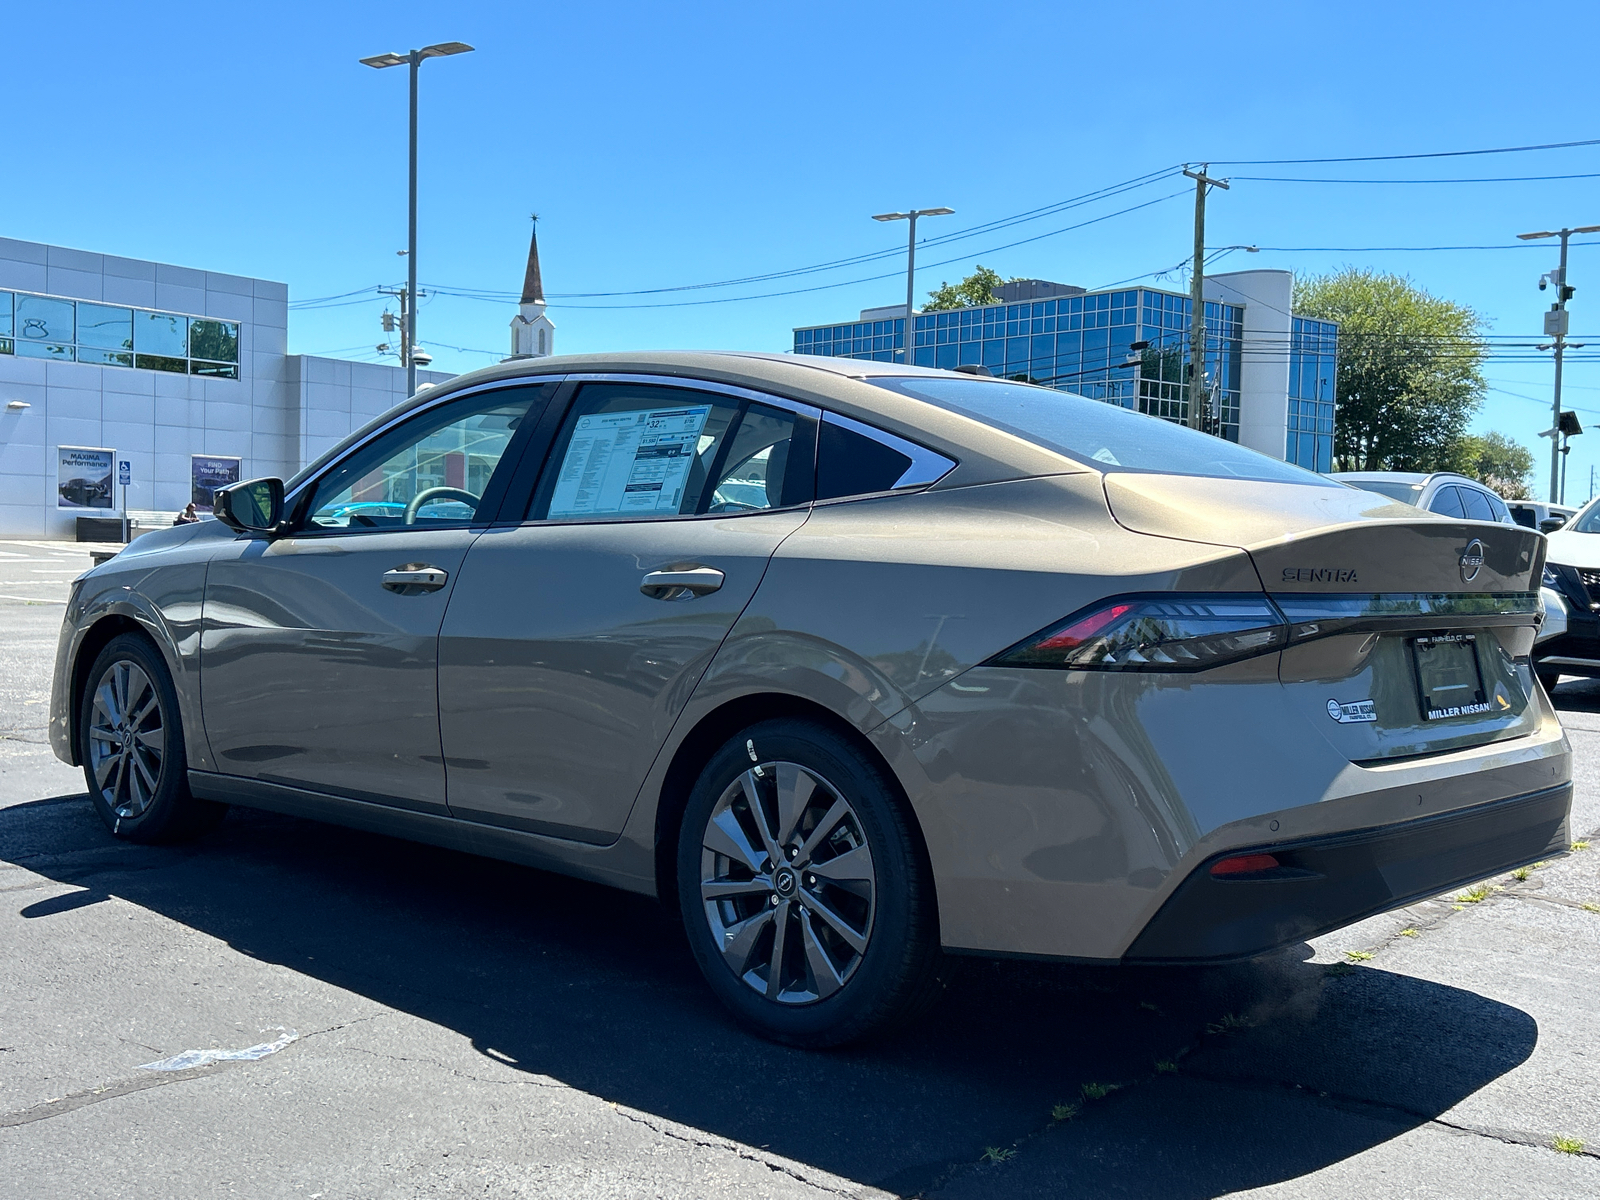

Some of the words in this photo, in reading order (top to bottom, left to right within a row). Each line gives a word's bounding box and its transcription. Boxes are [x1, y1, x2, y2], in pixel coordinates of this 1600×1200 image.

[650, 420, 660, 428] 32
[70, 453, 100, 461] MAXIMA
[62, 459, 108, 468] Performance
[1282, 567, 1358, 583] SENTRA
[1341, 704, 1359, 716] MILLER
[1358, 703, 1376, 714] NISSAN
[1428, 707, 1460, 720] MILLER
[1461, 702, 1490, 715] NISSAN
